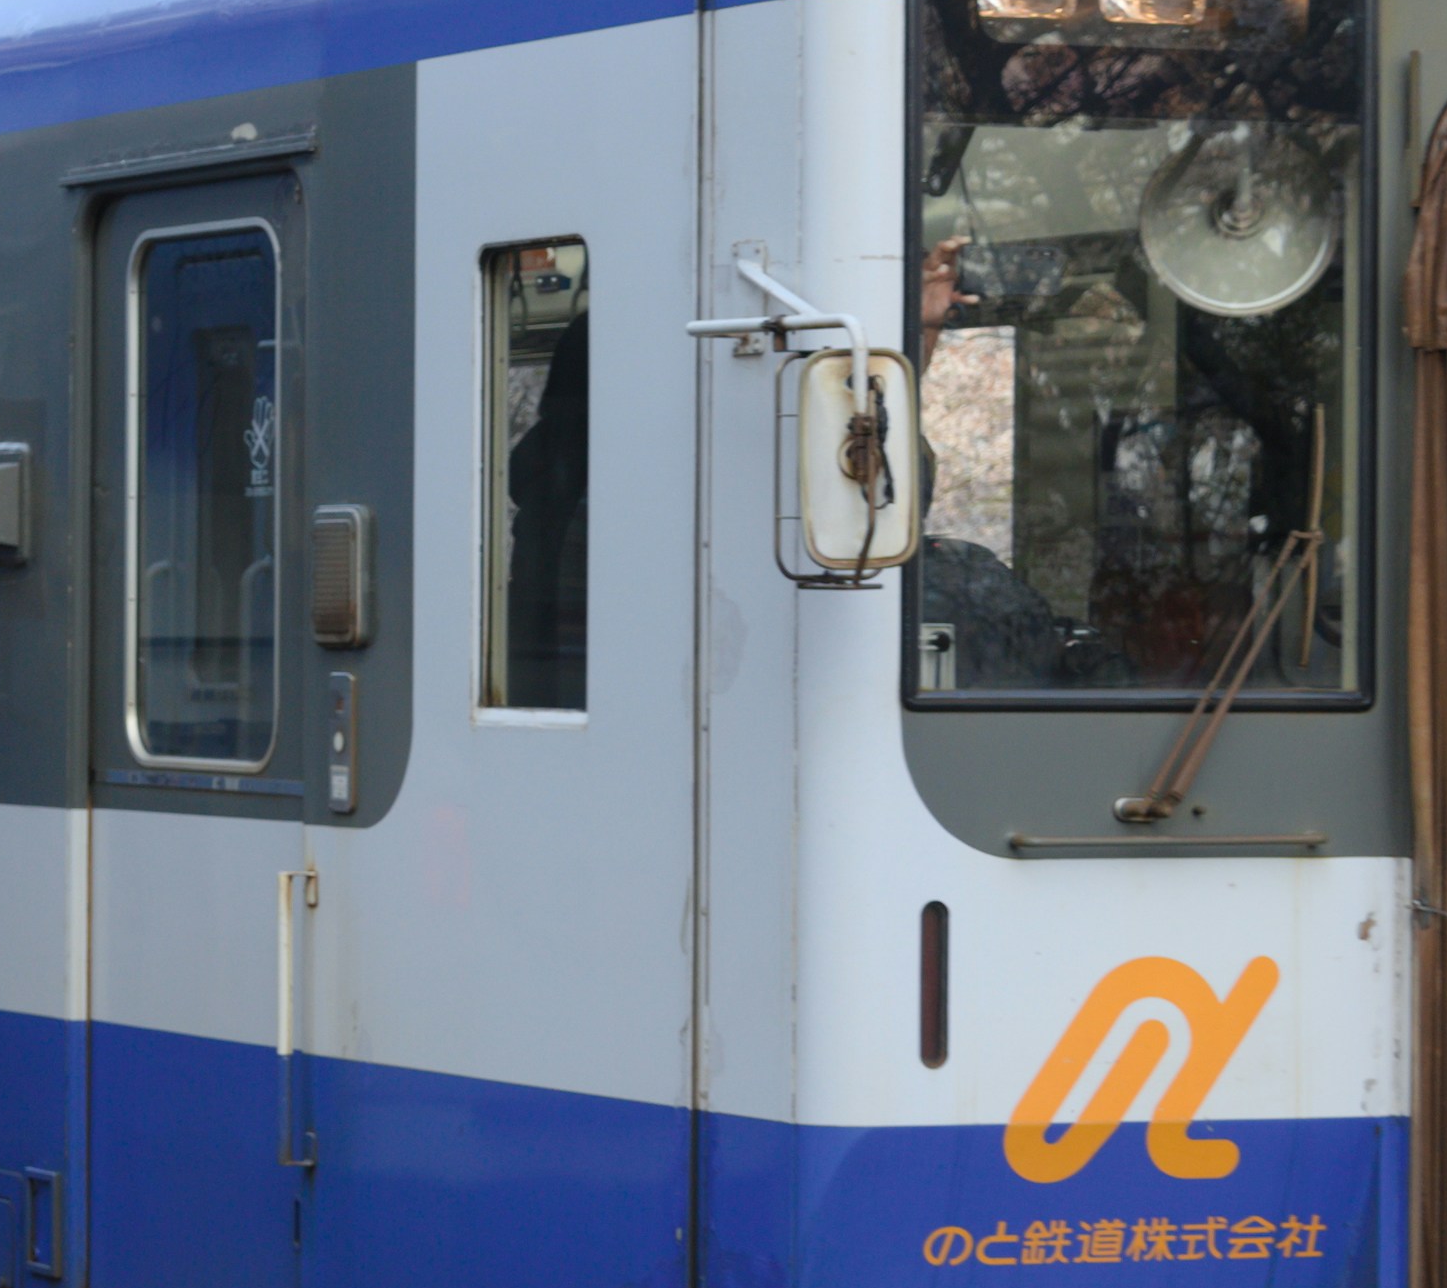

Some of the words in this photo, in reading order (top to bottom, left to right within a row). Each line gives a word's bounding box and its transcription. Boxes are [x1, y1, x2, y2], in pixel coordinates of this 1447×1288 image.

[922, 1214, 1327, 1267] のと鉄道株式会社
